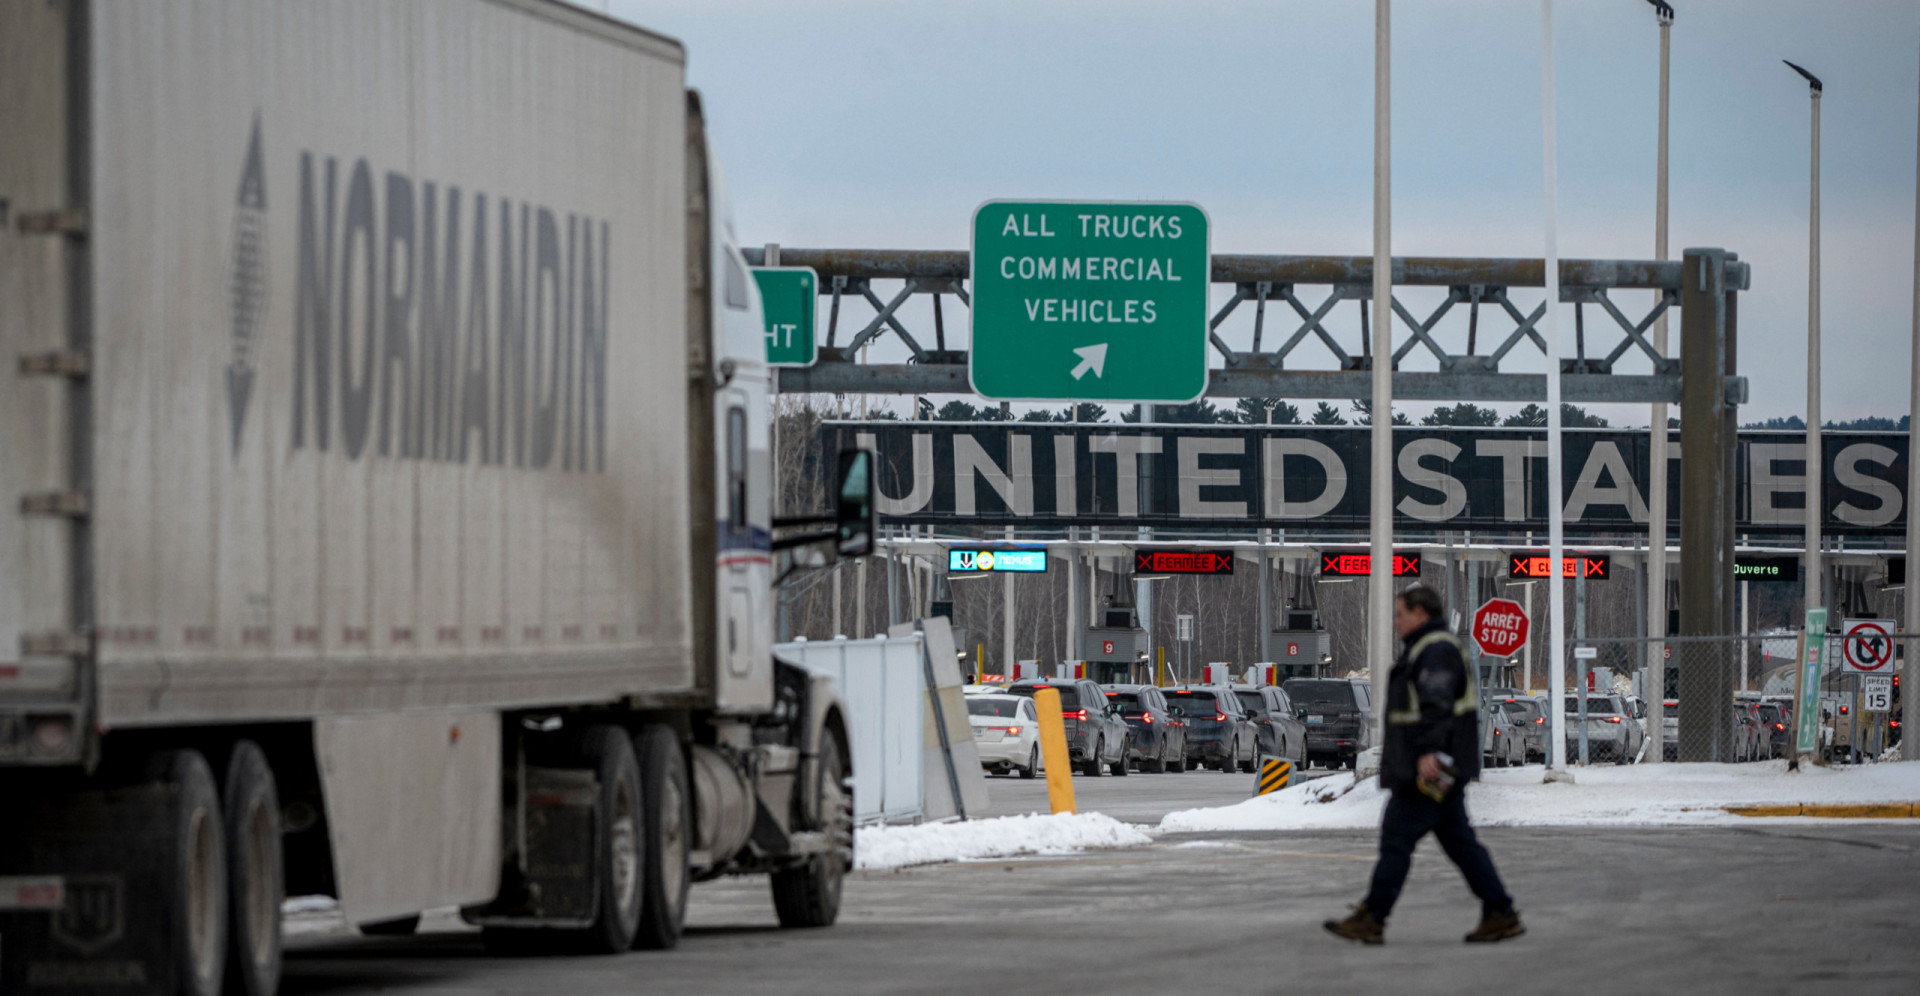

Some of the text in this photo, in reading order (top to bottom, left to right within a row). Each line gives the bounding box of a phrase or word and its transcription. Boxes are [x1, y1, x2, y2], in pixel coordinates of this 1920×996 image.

[1002, 213, 1183, 240] ALL TRUCKS
[1000, 255, 1182, 282] COMMERCIAL
[292, 149, 610, 474] NORMANDIN
[1024, 298, 1157, 323] VEHICLES
[856, 432, 1903, 528] UNITED STAES
[1157, 553, 1210, 569] FERMÉE
[1734, 563, 1779, 575] Ouverte
[1482, 611, 1522, 631] ARRÊT
[1481, 628, 1518, 646] STOP
[1105, 643, 1114, 654] 9
[1289, 645, 1297, 656] 8
[1866, 678, 1890, 686] SPEED
[1869, 694, 1886, 708] 15
